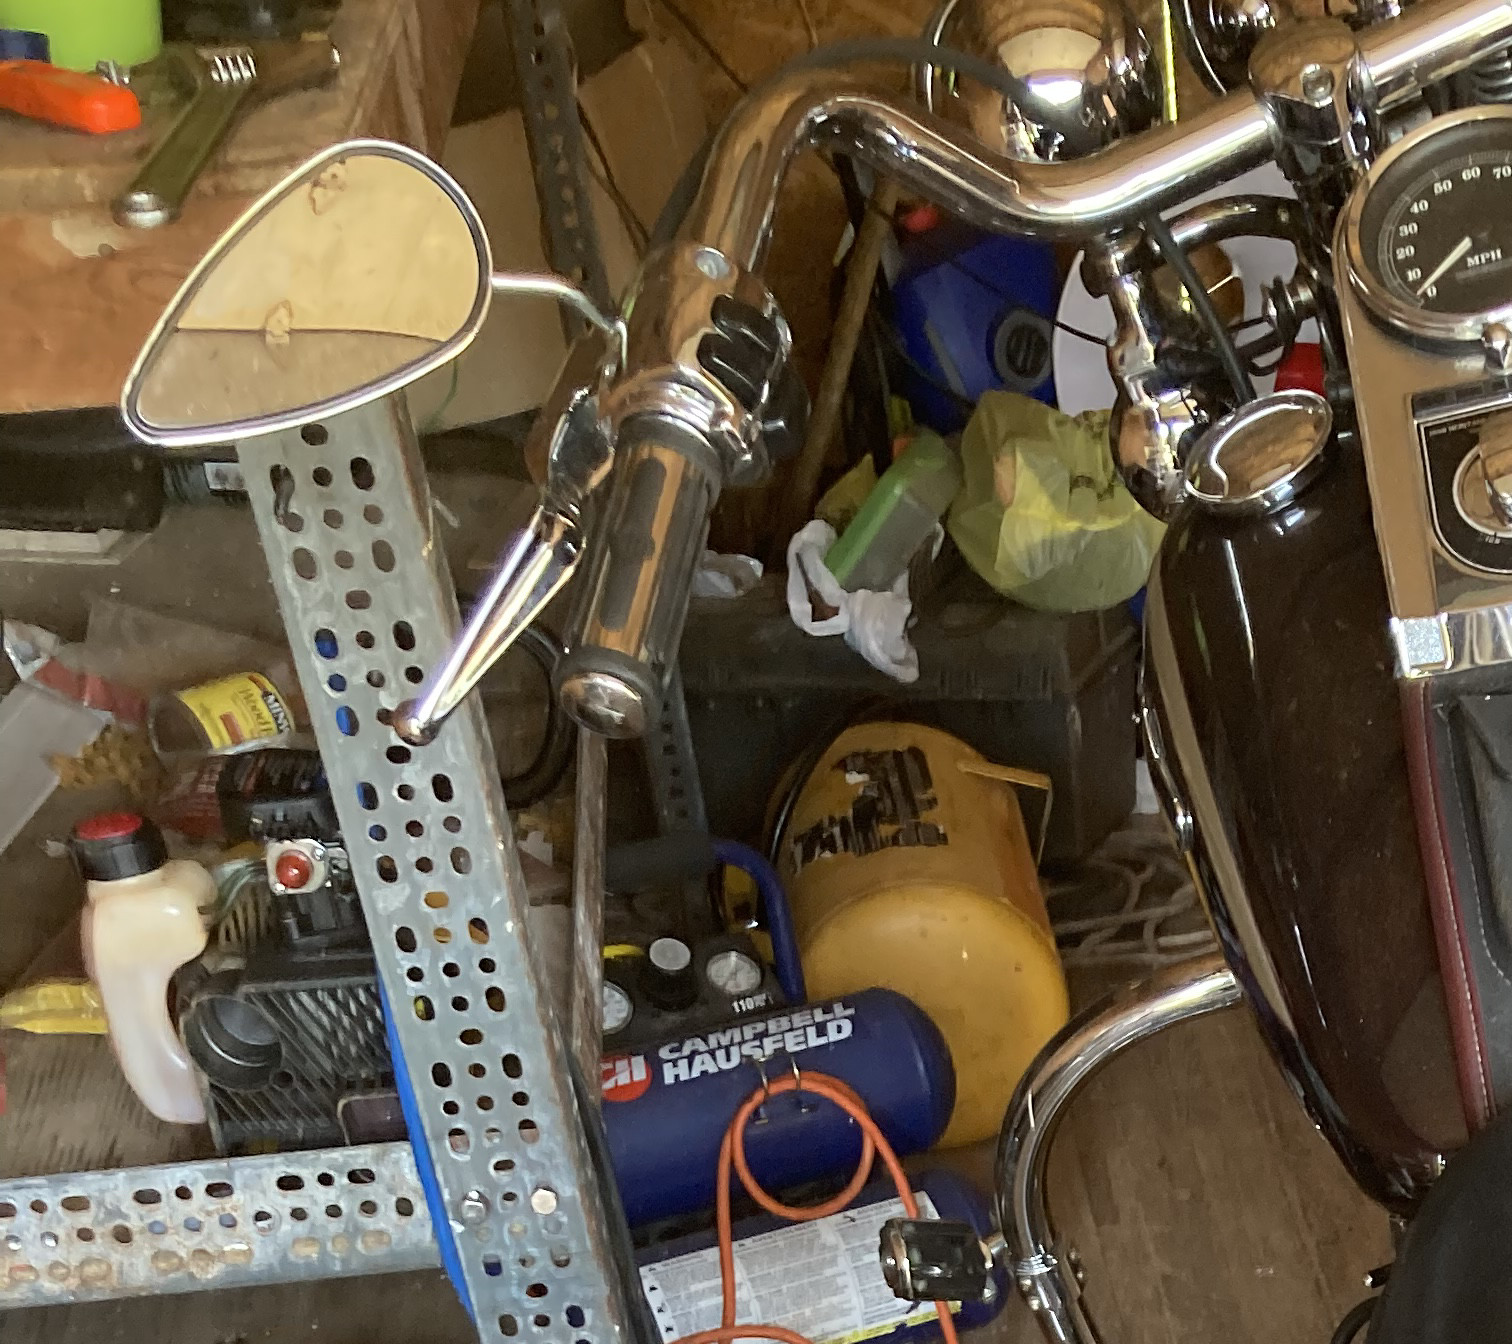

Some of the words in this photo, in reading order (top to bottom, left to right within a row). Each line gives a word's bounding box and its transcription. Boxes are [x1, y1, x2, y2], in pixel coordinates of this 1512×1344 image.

[1461, 166, 1481, 182] 60
[1492, 165, 1512, 180] 70
[1433, 179, 1453, 196] 50
[1409, 199, 1429, 214] 40
[1398, 222, 1419, 237] 30
[1395, 245, 1416, 260] 20
[1466, 249, 1503, 268] MPH
[1406, 268, 1422, 282] 10
[1426, 285, 1438, 299] 0
[658, 1002, 856, 1060] CAMPBELL
[662, 1018, 853, 1086] HAUSFELD
